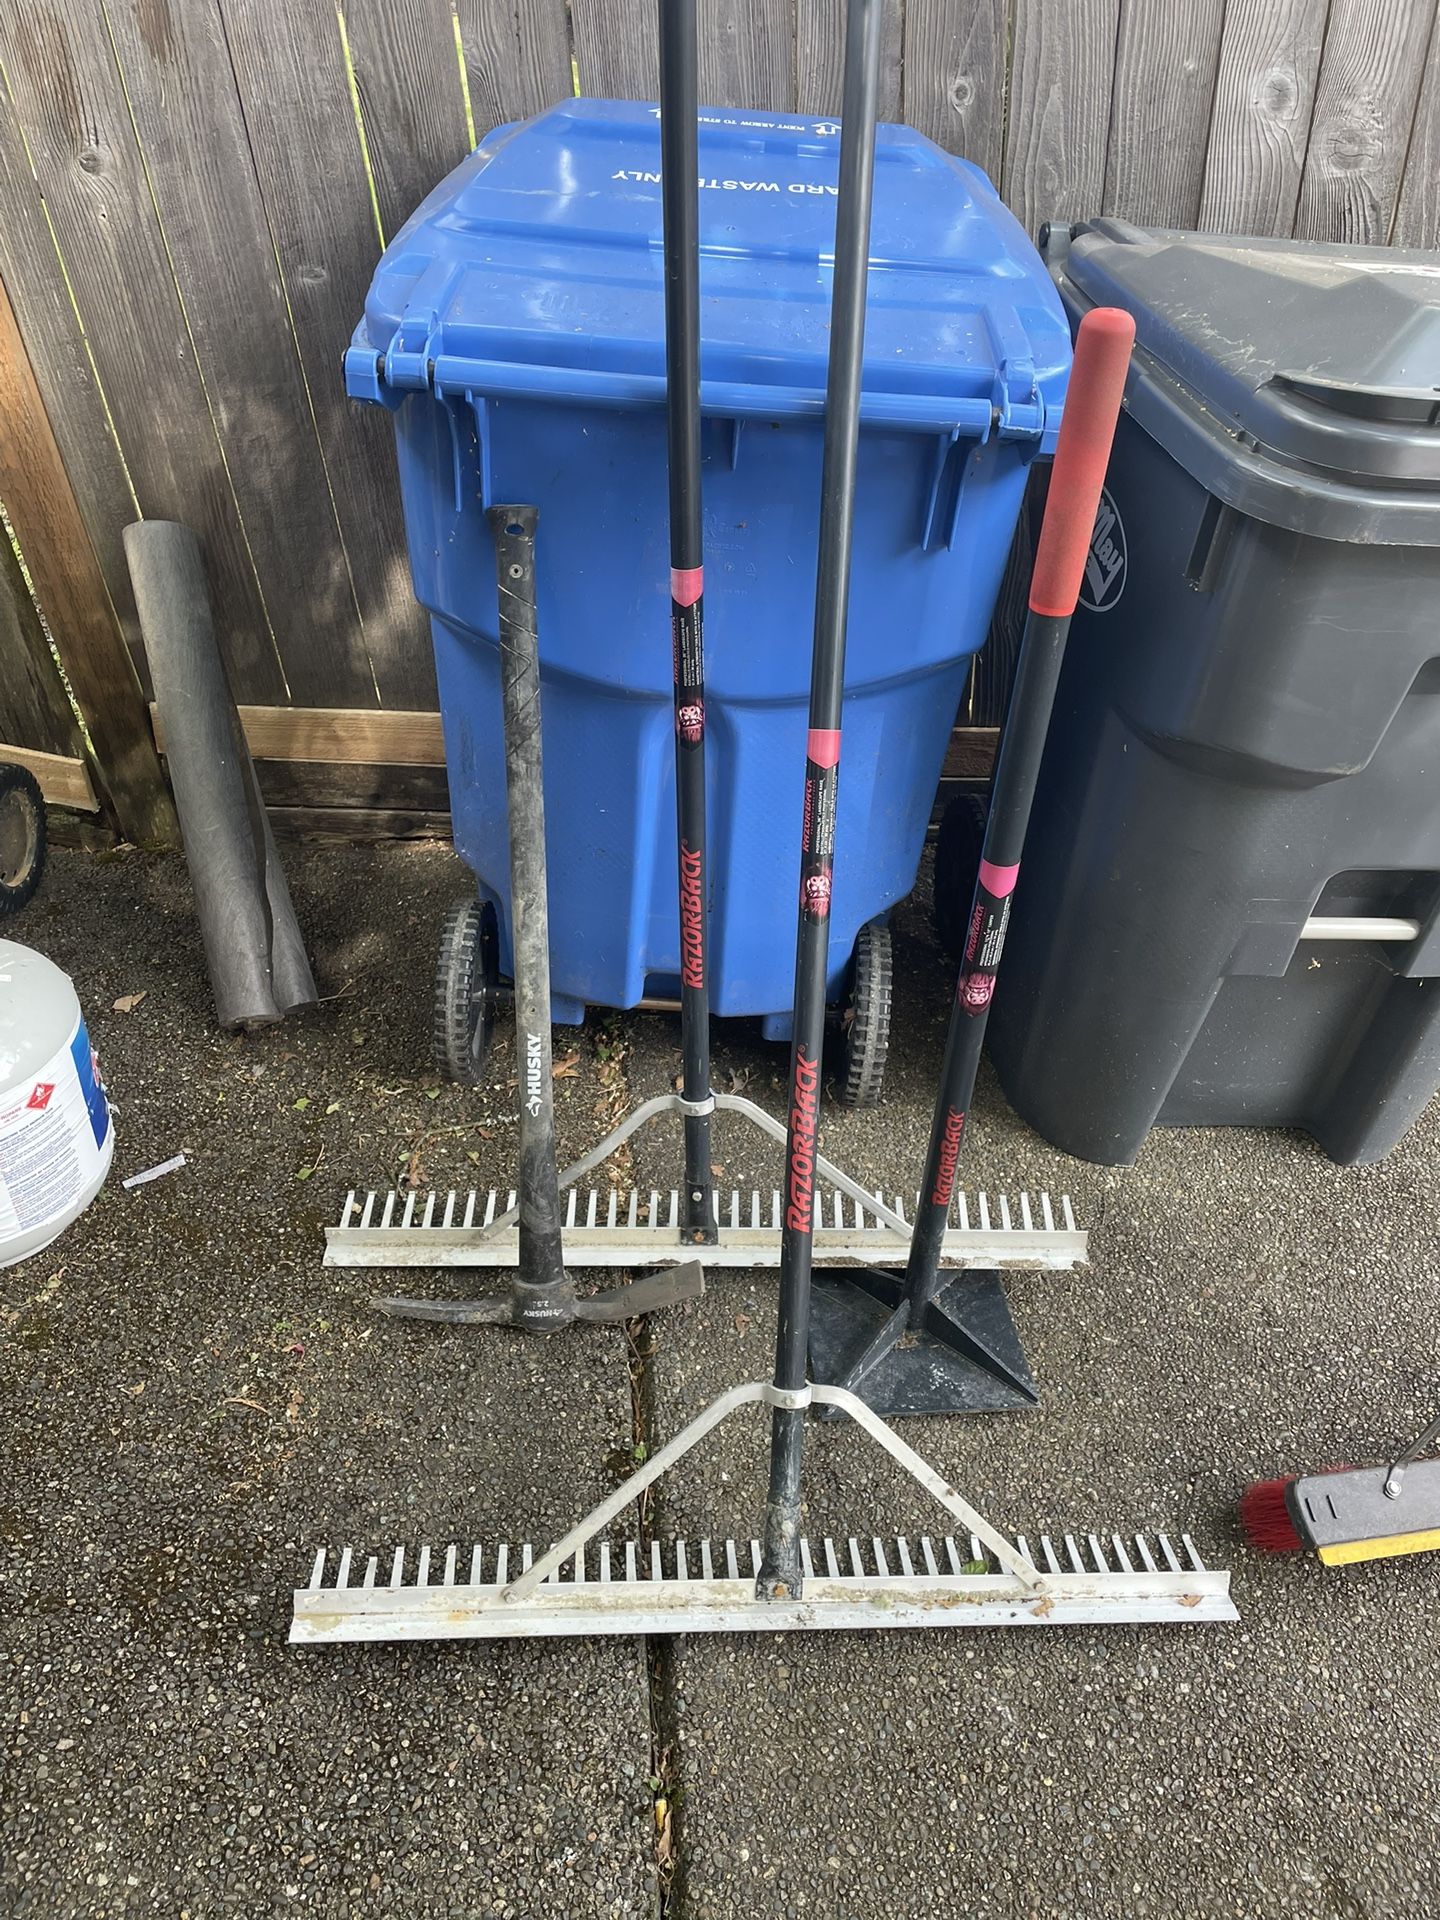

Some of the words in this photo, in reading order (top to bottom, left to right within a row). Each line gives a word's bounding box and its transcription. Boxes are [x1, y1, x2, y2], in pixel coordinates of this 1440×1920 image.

[697, 116, 722, 124] STRE
[740, 120, 775, 129] ARROW
[611, 170, 662, 183] NLY
[788, 183, 839, 196] ARD
[681, 850, 703, 990] RAZORBACK
[527, 1032, 542, 1095] HUSKY
[787, 1052, 818, 1234] RAZORBACK
[931, 1106, 965, 1207] RAZORBACK
[523, 1309, 553, 1318] HUSKY
